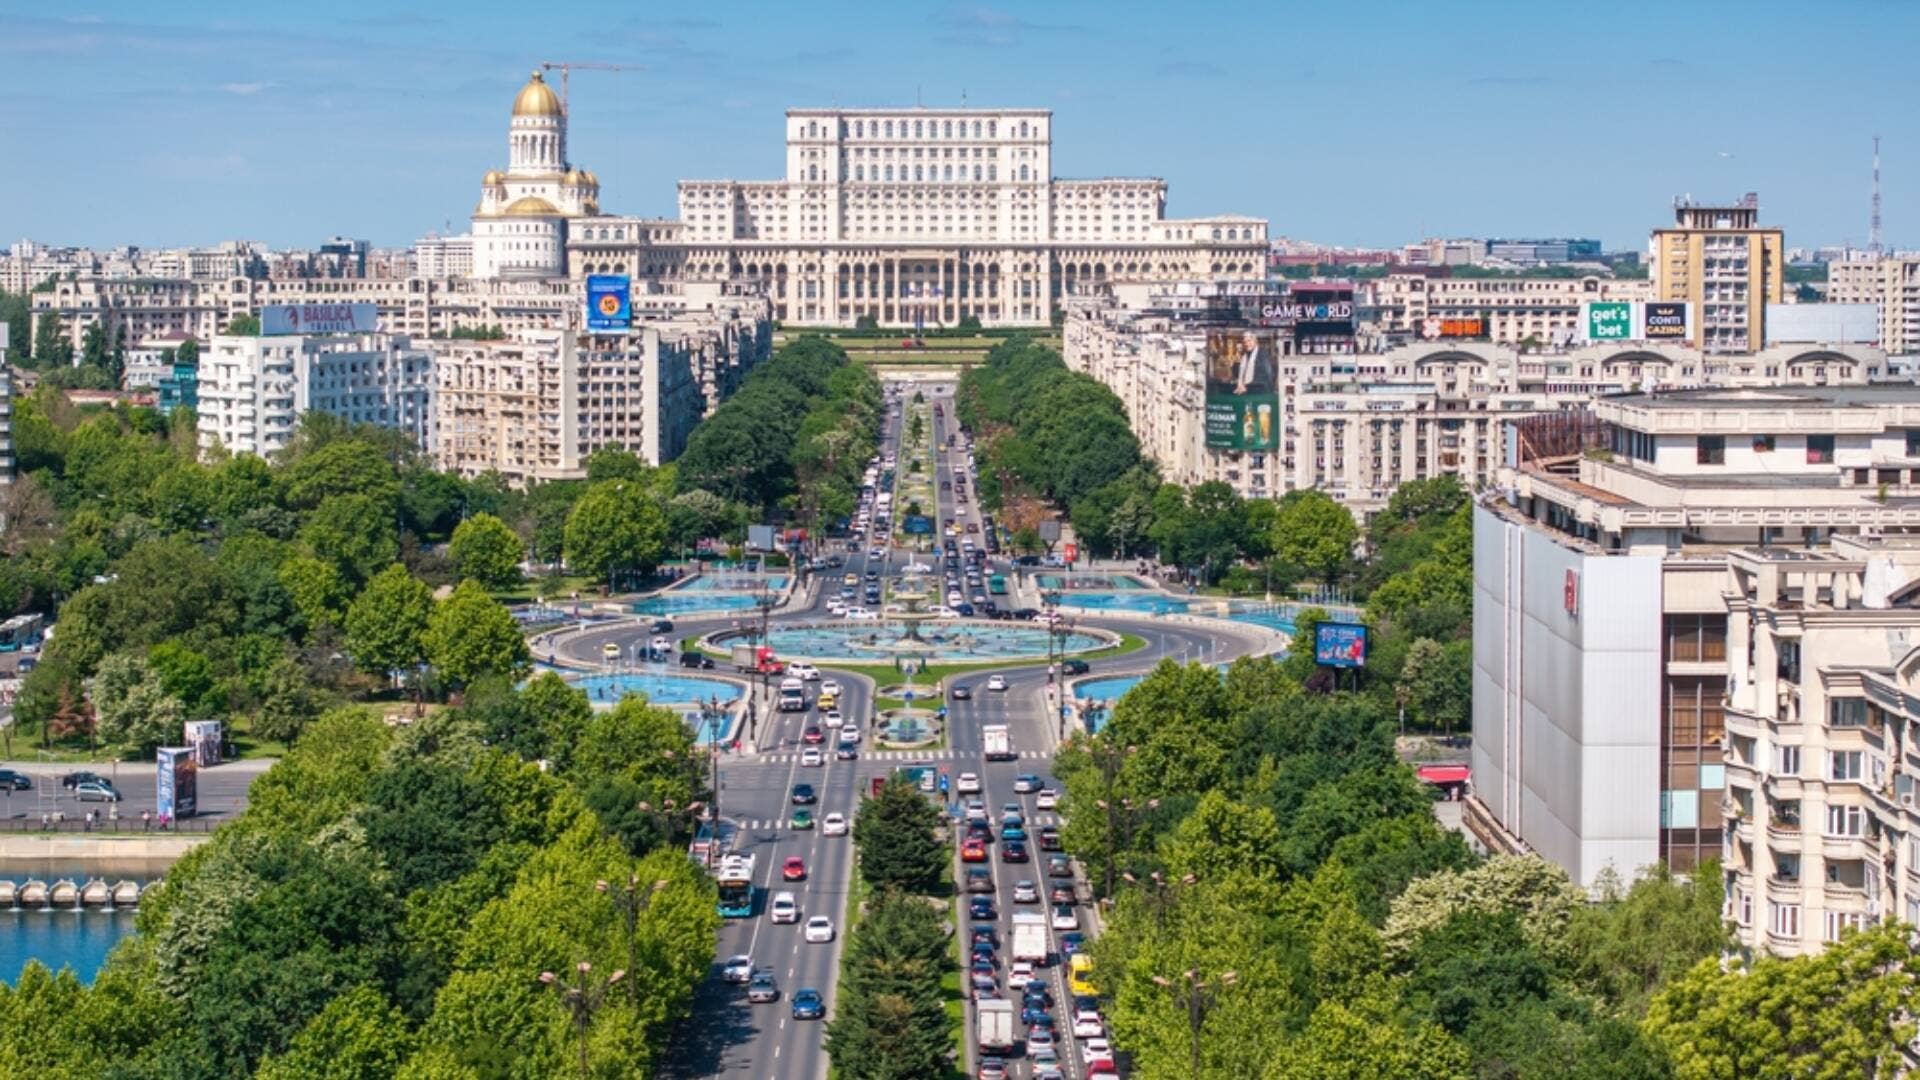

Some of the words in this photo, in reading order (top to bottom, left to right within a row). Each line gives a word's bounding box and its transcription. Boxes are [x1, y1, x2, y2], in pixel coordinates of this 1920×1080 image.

[1262, 304, 1301, 318] GAME
[1304, 303, 1351, 319] WORLD
[1591, 305, 1628, 323] get's
[1648, 316, 1681, 325] CONTI
[1596, 323, 1622, 336] bet
[1647, 326, 1685, 335] CAZINO
